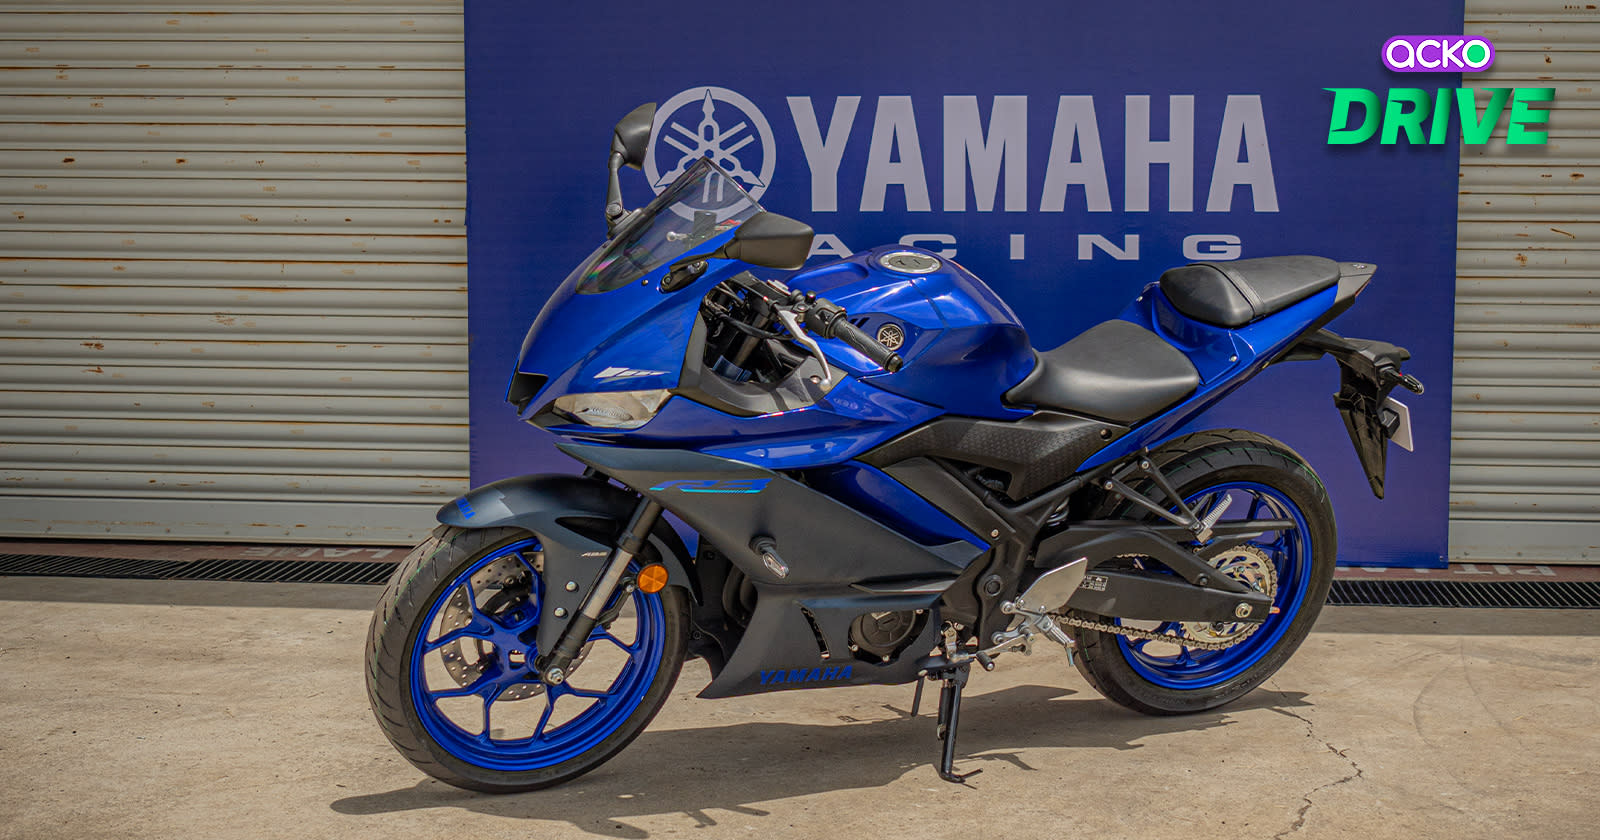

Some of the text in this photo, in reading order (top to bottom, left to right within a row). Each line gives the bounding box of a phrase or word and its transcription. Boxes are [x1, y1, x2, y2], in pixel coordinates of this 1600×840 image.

[787, 95, 1279, 212] YAMAHA
[807, 234, 1241, 259] ACING
[760, 666, 853, 685] YAMAHA
